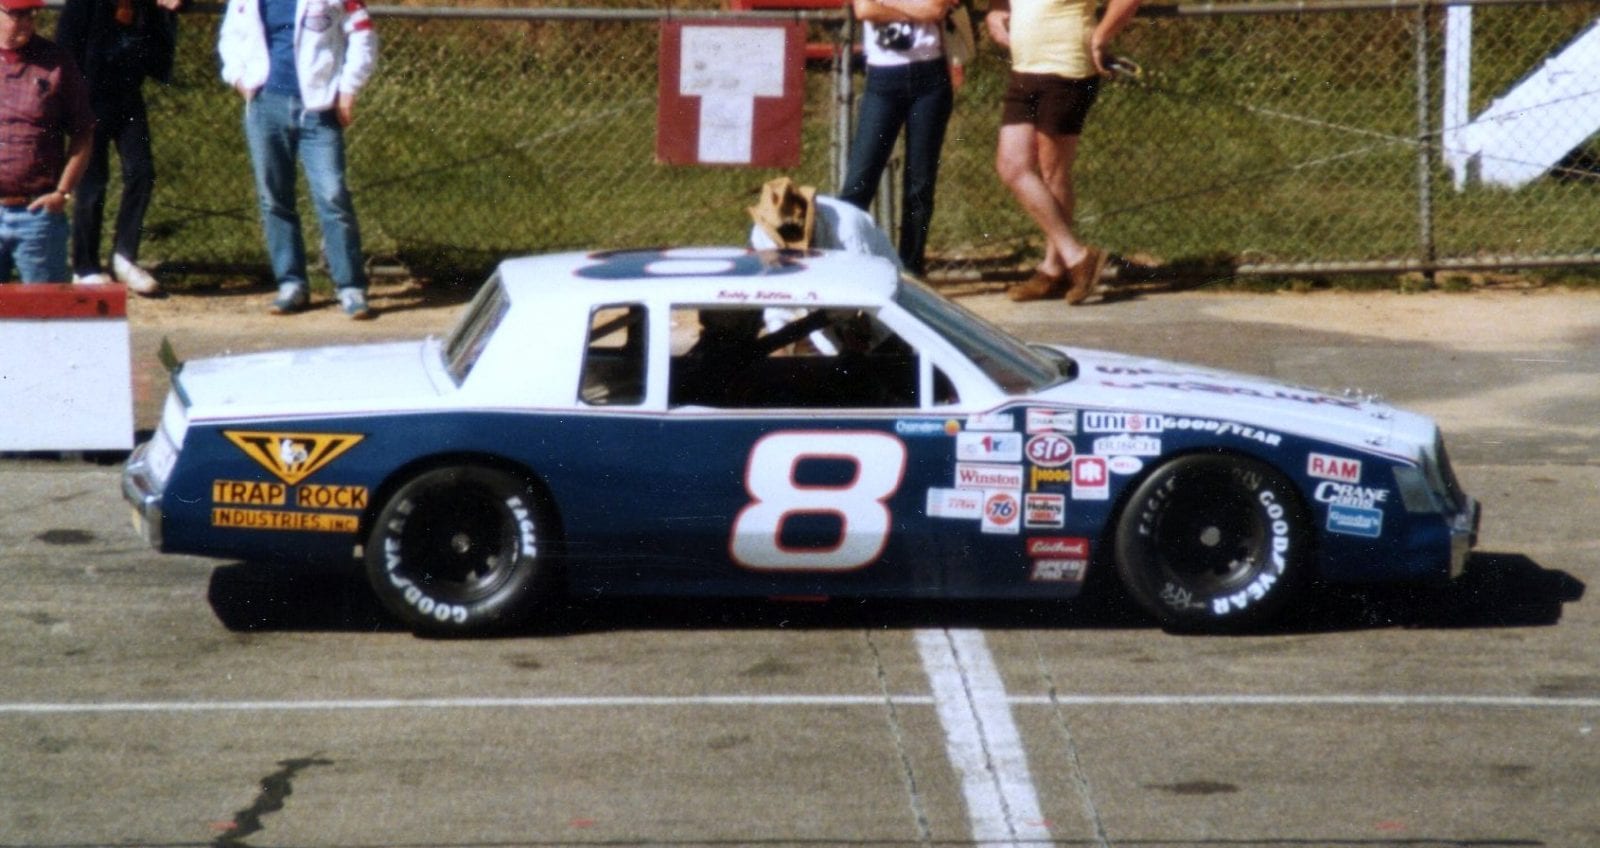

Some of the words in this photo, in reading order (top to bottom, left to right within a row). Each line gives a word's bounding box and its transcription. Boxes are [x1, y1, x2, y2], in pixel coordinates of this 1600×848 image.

[1031, 437, 1069, 460] STP
[959, 468, 1021, 487] Winston
[1312, 457, 1358, 479] RAM
[213, 482, 284, 503] TRAP
[299, 486, 367, 508] ROCK
[728, 429, 908, 572] 8
[1314, 481, 1391, 503] CRANE
[1028, 501, 1062, 515] Holley
[1212, 489, 1290, 616] GOODYEAR
